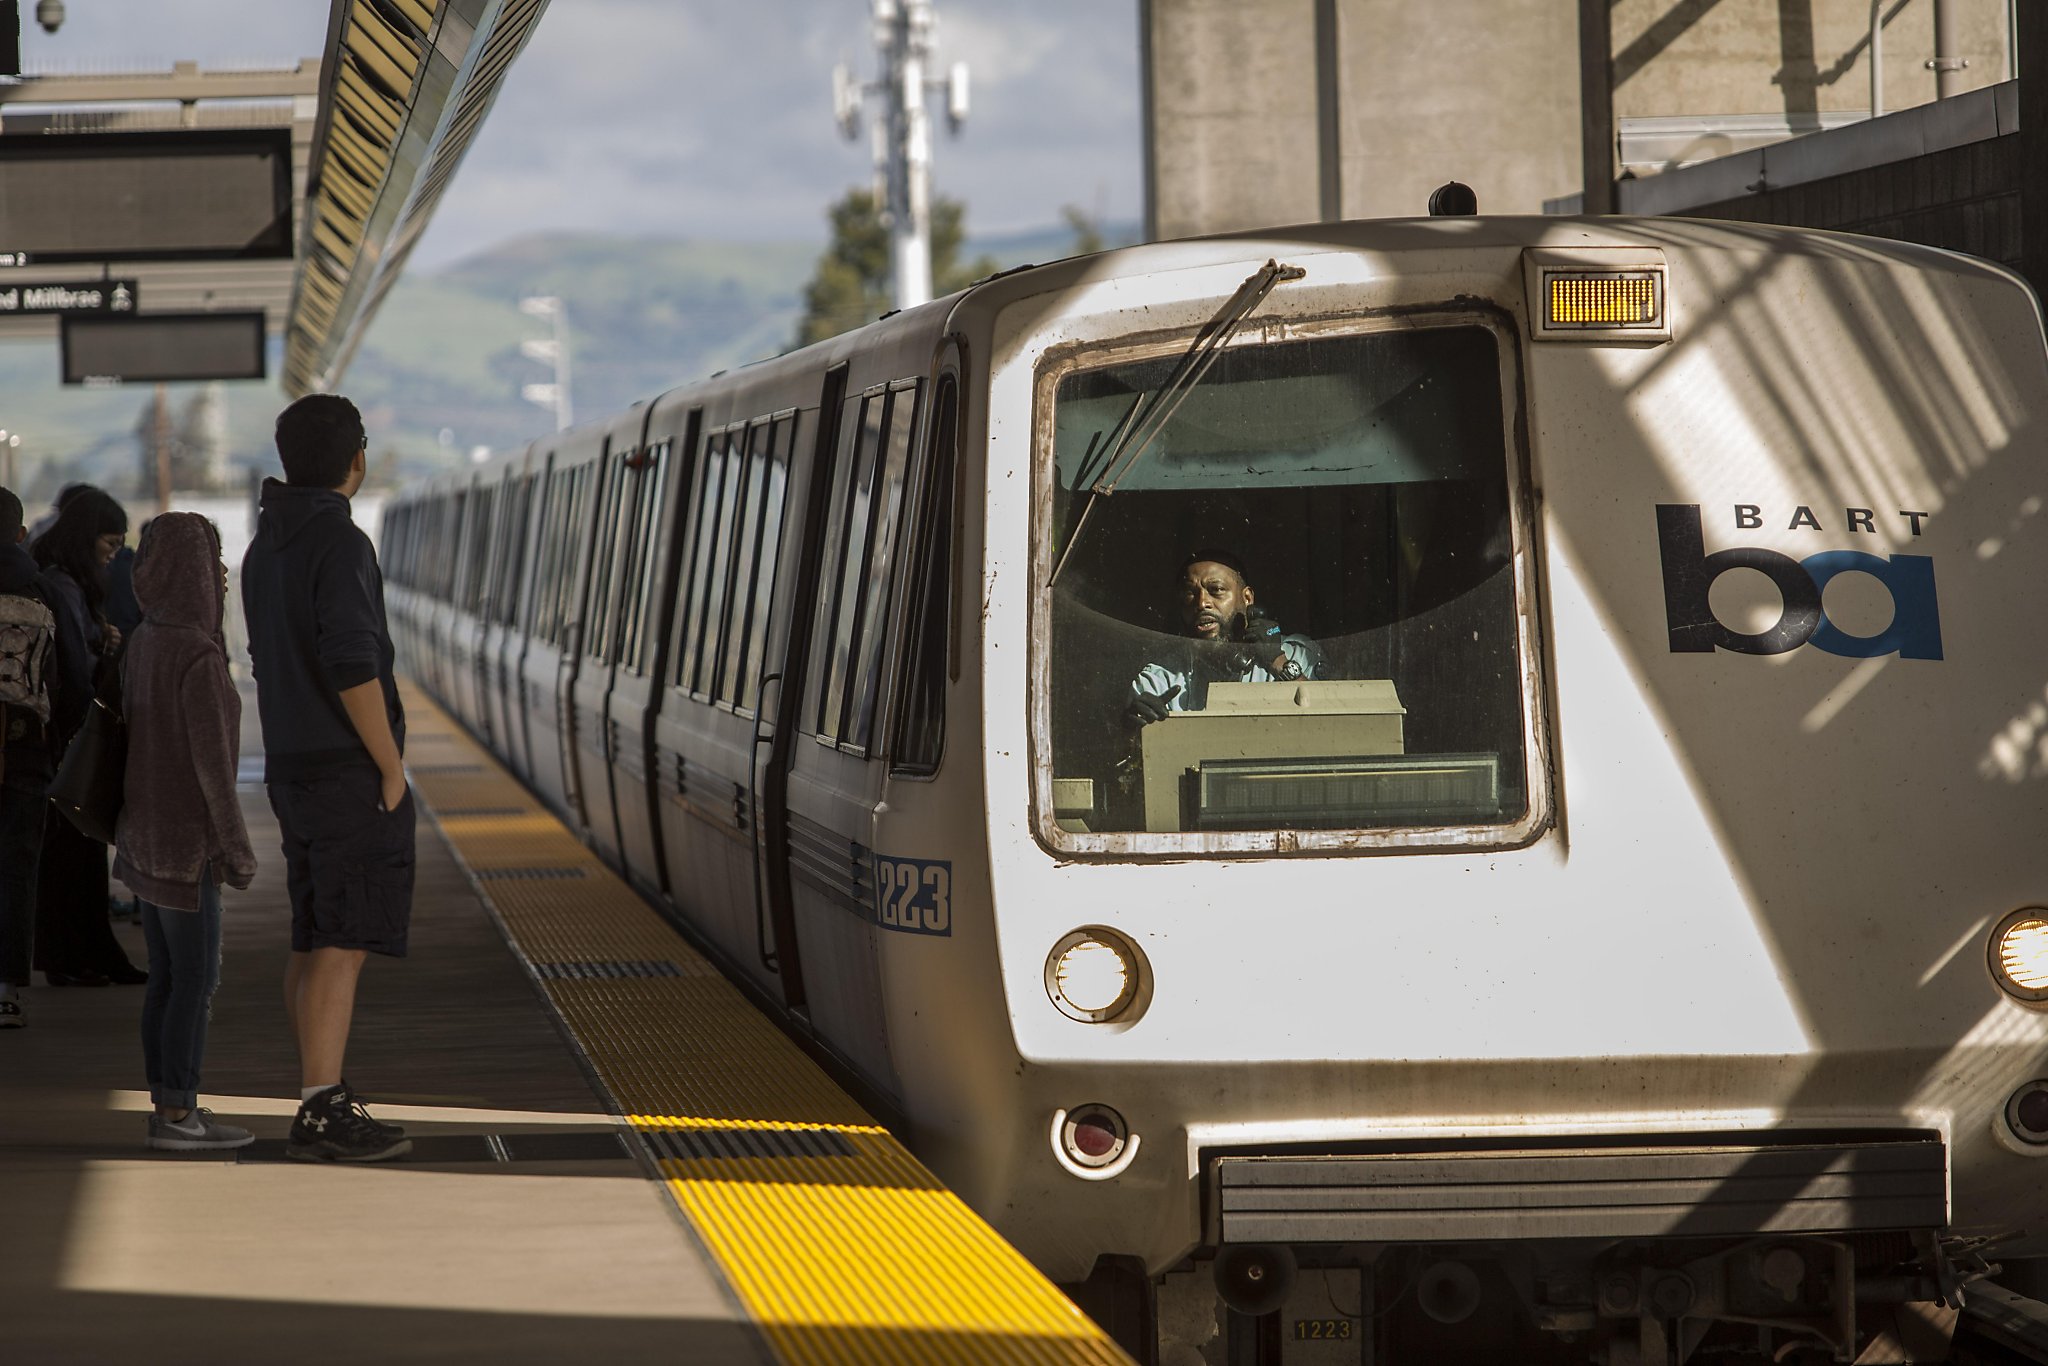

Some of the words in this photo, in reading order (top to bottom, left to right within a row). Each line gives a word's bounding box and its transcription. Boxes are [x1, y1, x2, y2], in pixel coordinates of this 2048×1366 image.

[23, 287, 102, 309] Millbrae
[1734, 504, 1928, 536] BART
[1655, 503, 1943, 660] ba
[1298, 1321, 1350, 1338] 1223
